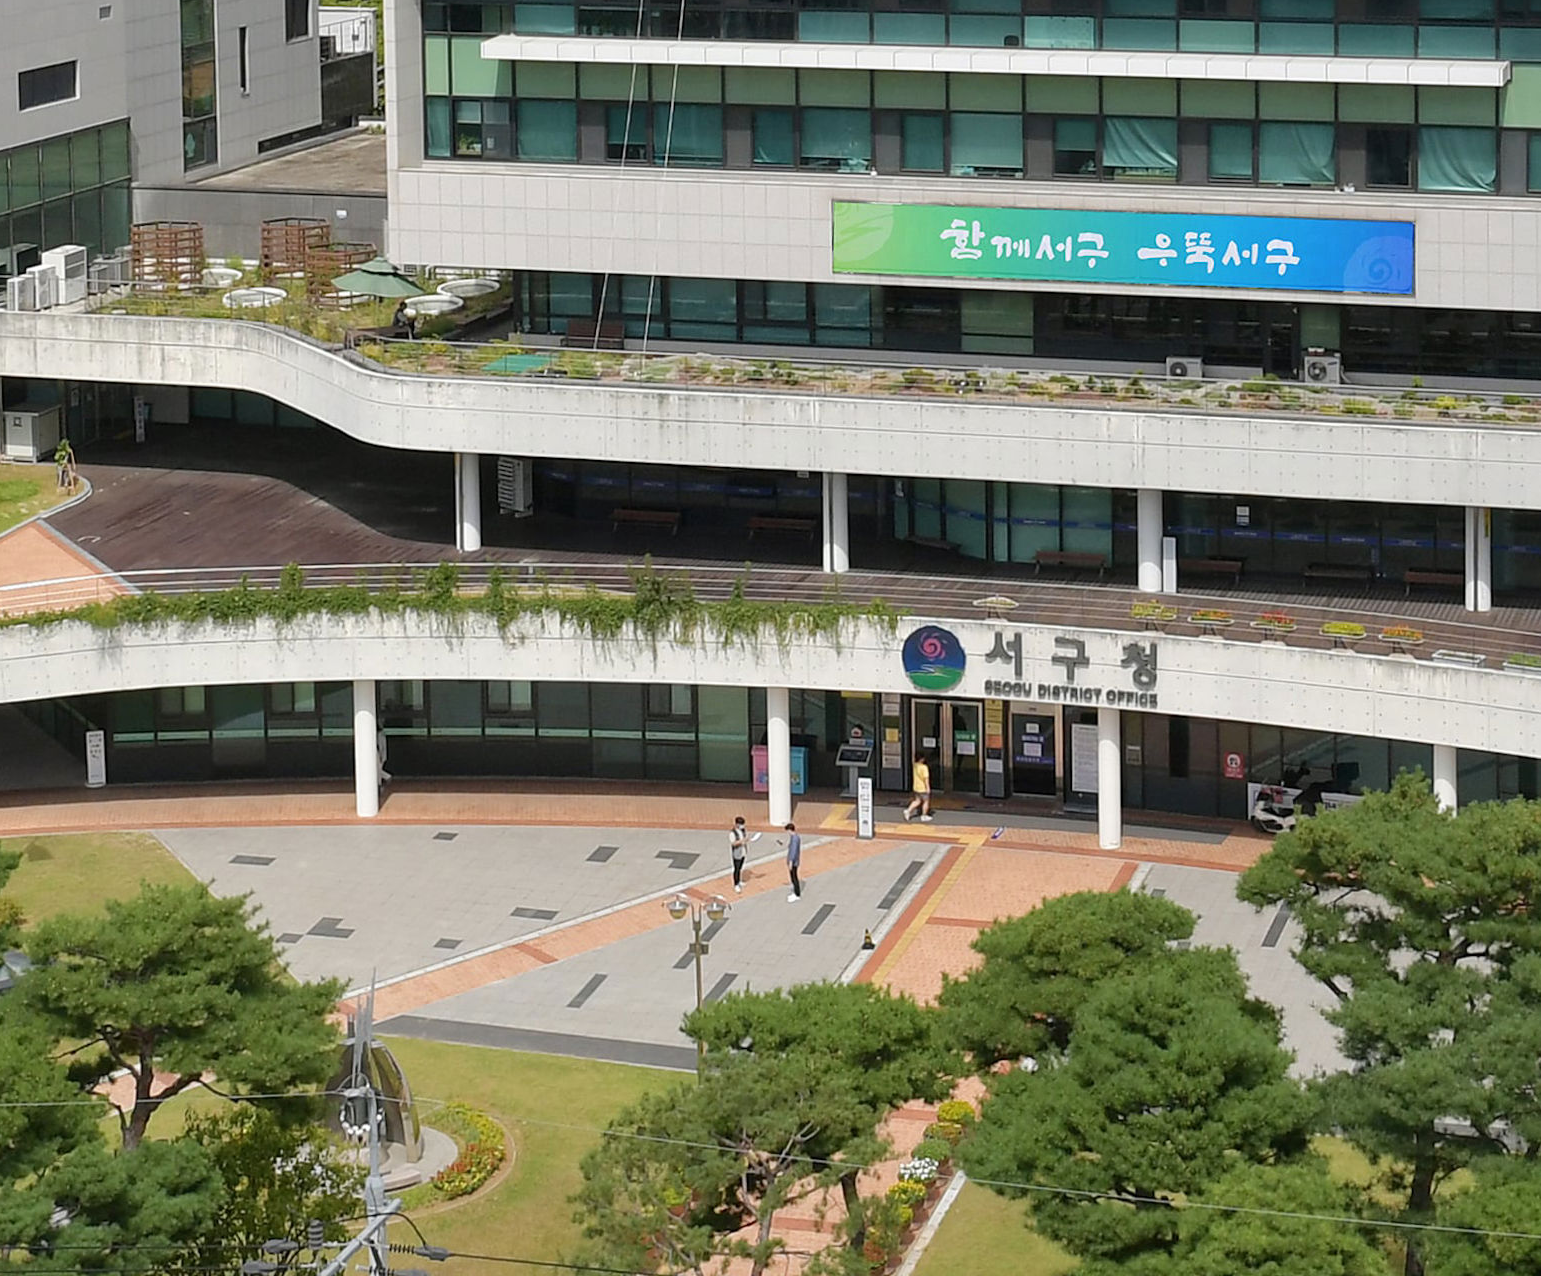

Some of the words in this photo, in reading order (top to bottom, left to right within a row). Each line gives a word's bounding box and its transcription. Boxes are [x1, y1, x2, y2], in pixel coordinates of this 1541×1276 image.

[940, 219, 1111, 268] 함께서구
[1137, 231, 1301, 276] 우뚝서구
[985, 631, 1159, 691] 서구청
[984, 679, 1033, 699] SEOGU
[1037, 683, 1104, 705] DISTRICT
[1105, 689, 1159, 709] OFFICE
